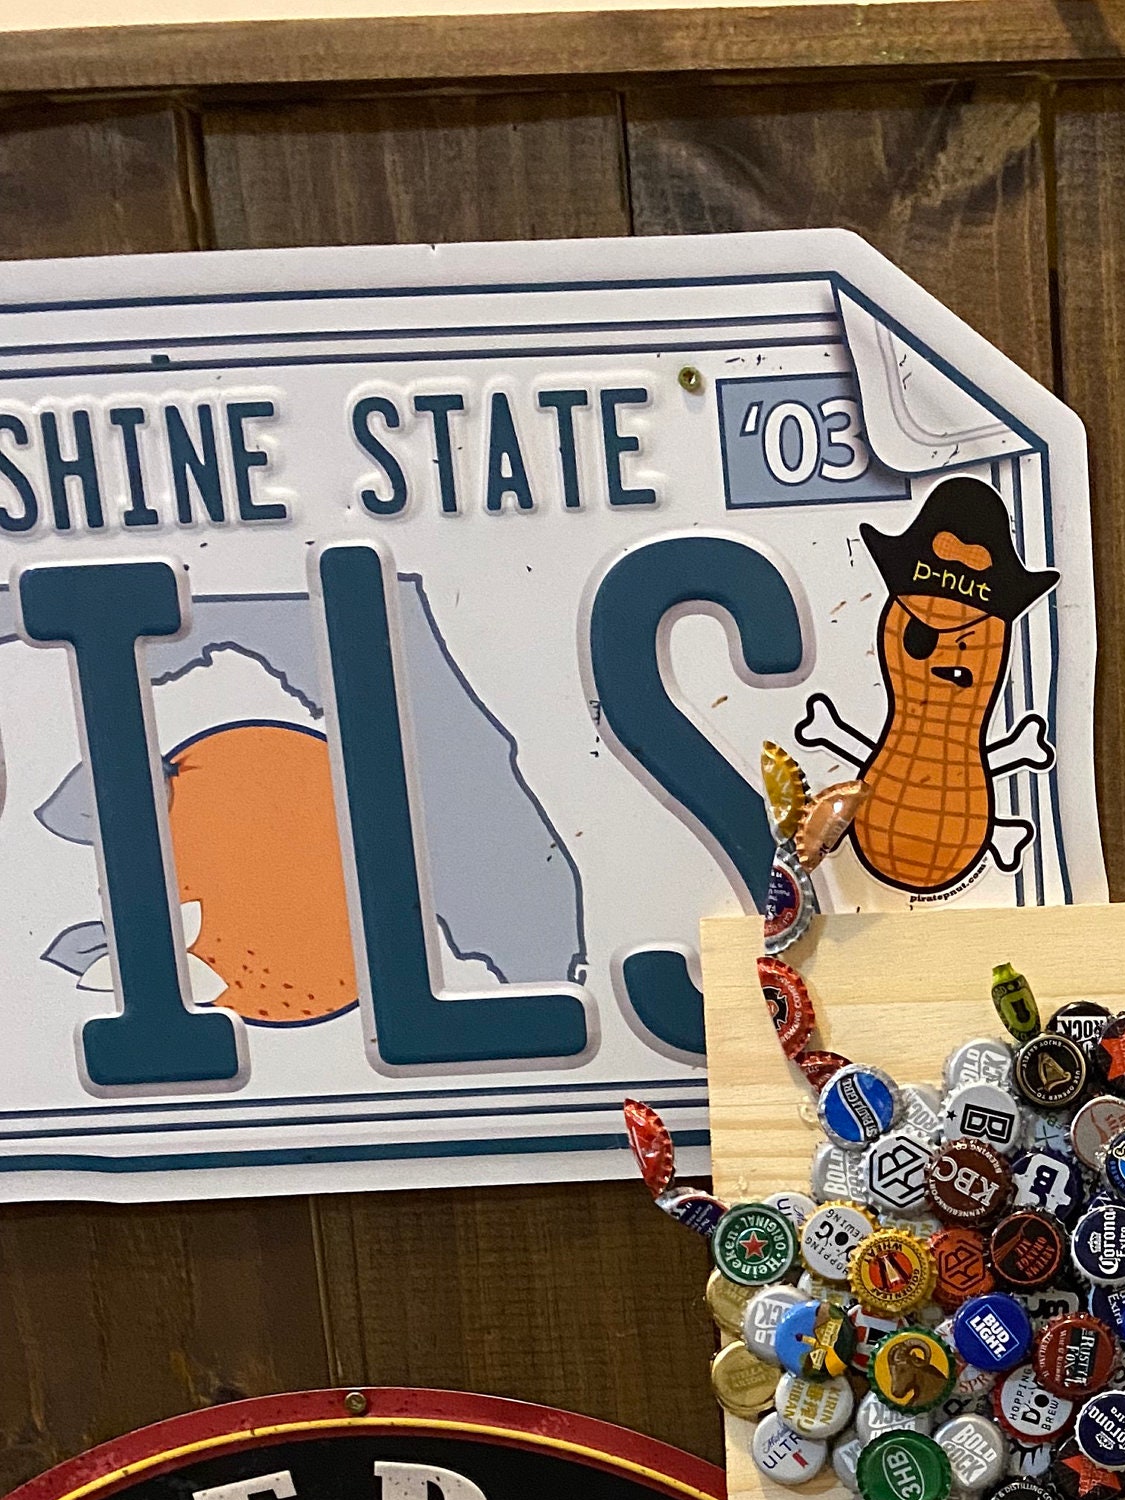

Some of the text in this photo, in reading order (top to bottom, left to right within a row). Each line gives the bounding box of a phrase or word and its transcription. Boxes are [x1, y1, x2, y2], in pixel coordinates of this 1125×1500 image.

[0, 387, 656, 532] SHINE STATE
[913, 560, 994, 601] p-nut
[20, 537, 804, 1086] ILS
[823, 1151, 849, 1196] BOLD
[932, 1156, 1000, 1205] KBC
[723, 1226, 786, 1278] Heineken
[740, 1215, 787, 1251] ORIGINAL
[865, 1242, 902, 1263] WHEAT
[1099, 1209, 1119, 1275] Corona
[982, 1313, 1010, 1345] BUD
[783, 1378, 806, 1421] HIBAN
[959, 1372, 992, 1394] SPR
[1009, 1367, 1034, 1422] HOPPING
[820, 1386, 841, 1426] KIRIN
[1041, 1398, 1061, 1432] BREW
[762, 1431, 803, 1470] ULTR
[951, 1422, 998, 1464] BOLD
[1004, 1481, 1044, 1496] DISTILLING
